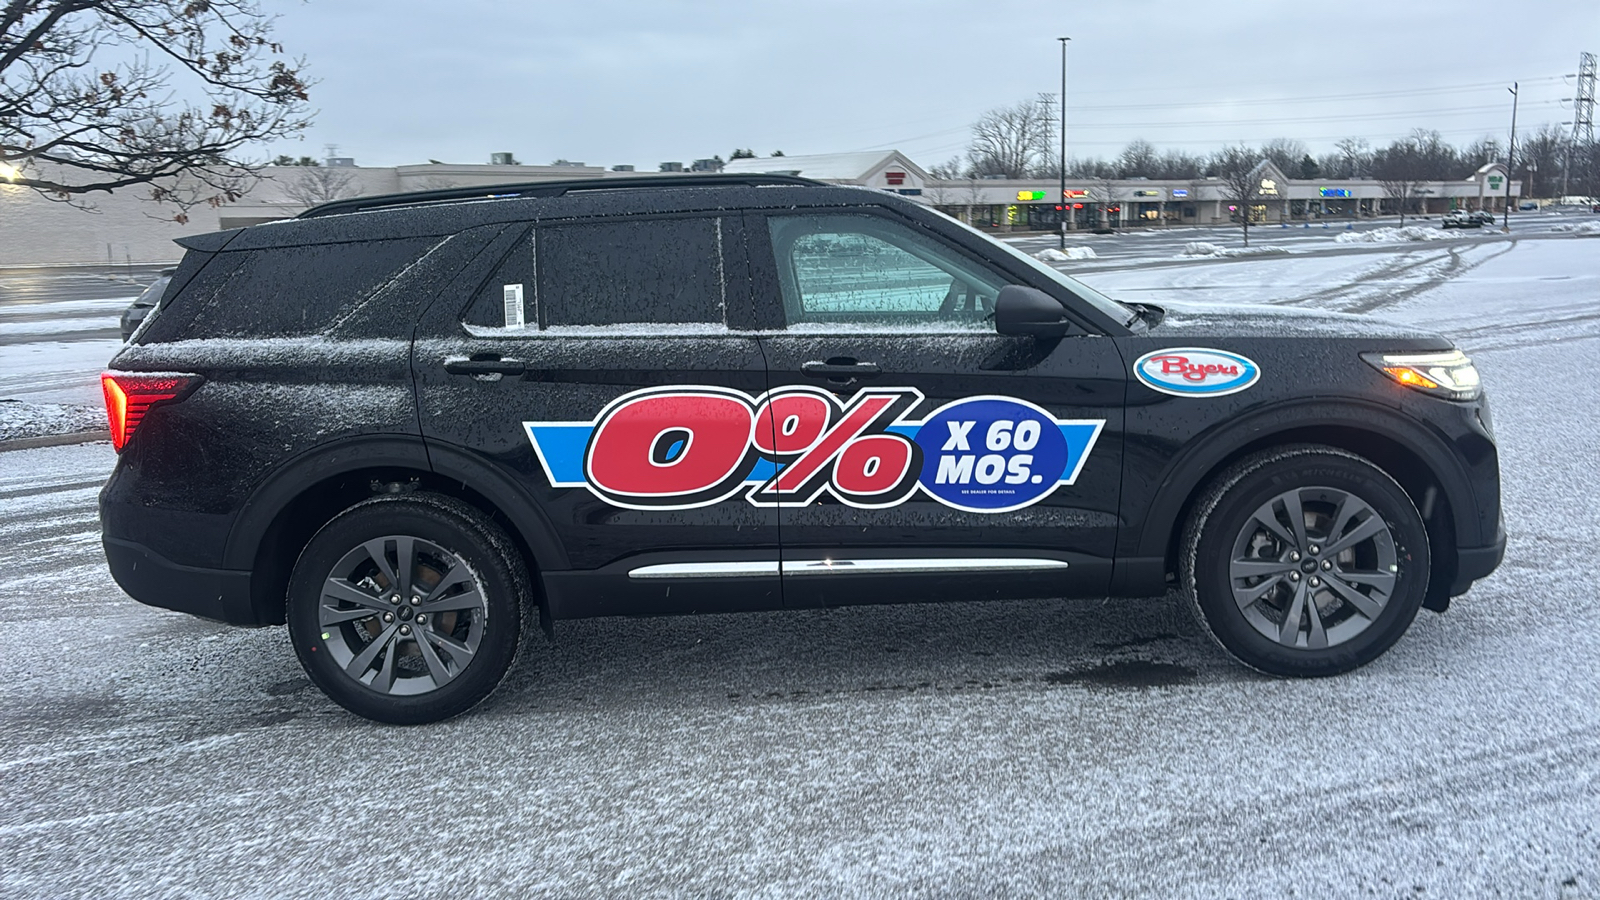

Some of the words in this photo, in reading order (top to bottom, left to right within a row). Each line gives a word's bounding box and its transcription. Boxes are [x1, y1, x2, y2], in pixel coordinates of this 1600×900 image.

[1150, 355, 1238, 381] Byers
[587, 391, 912, 498] 0%
[941, 421, 976, 451] X
[986, 420, 1041, 451] 60
[935, 454, 1043, 485] MOS.
